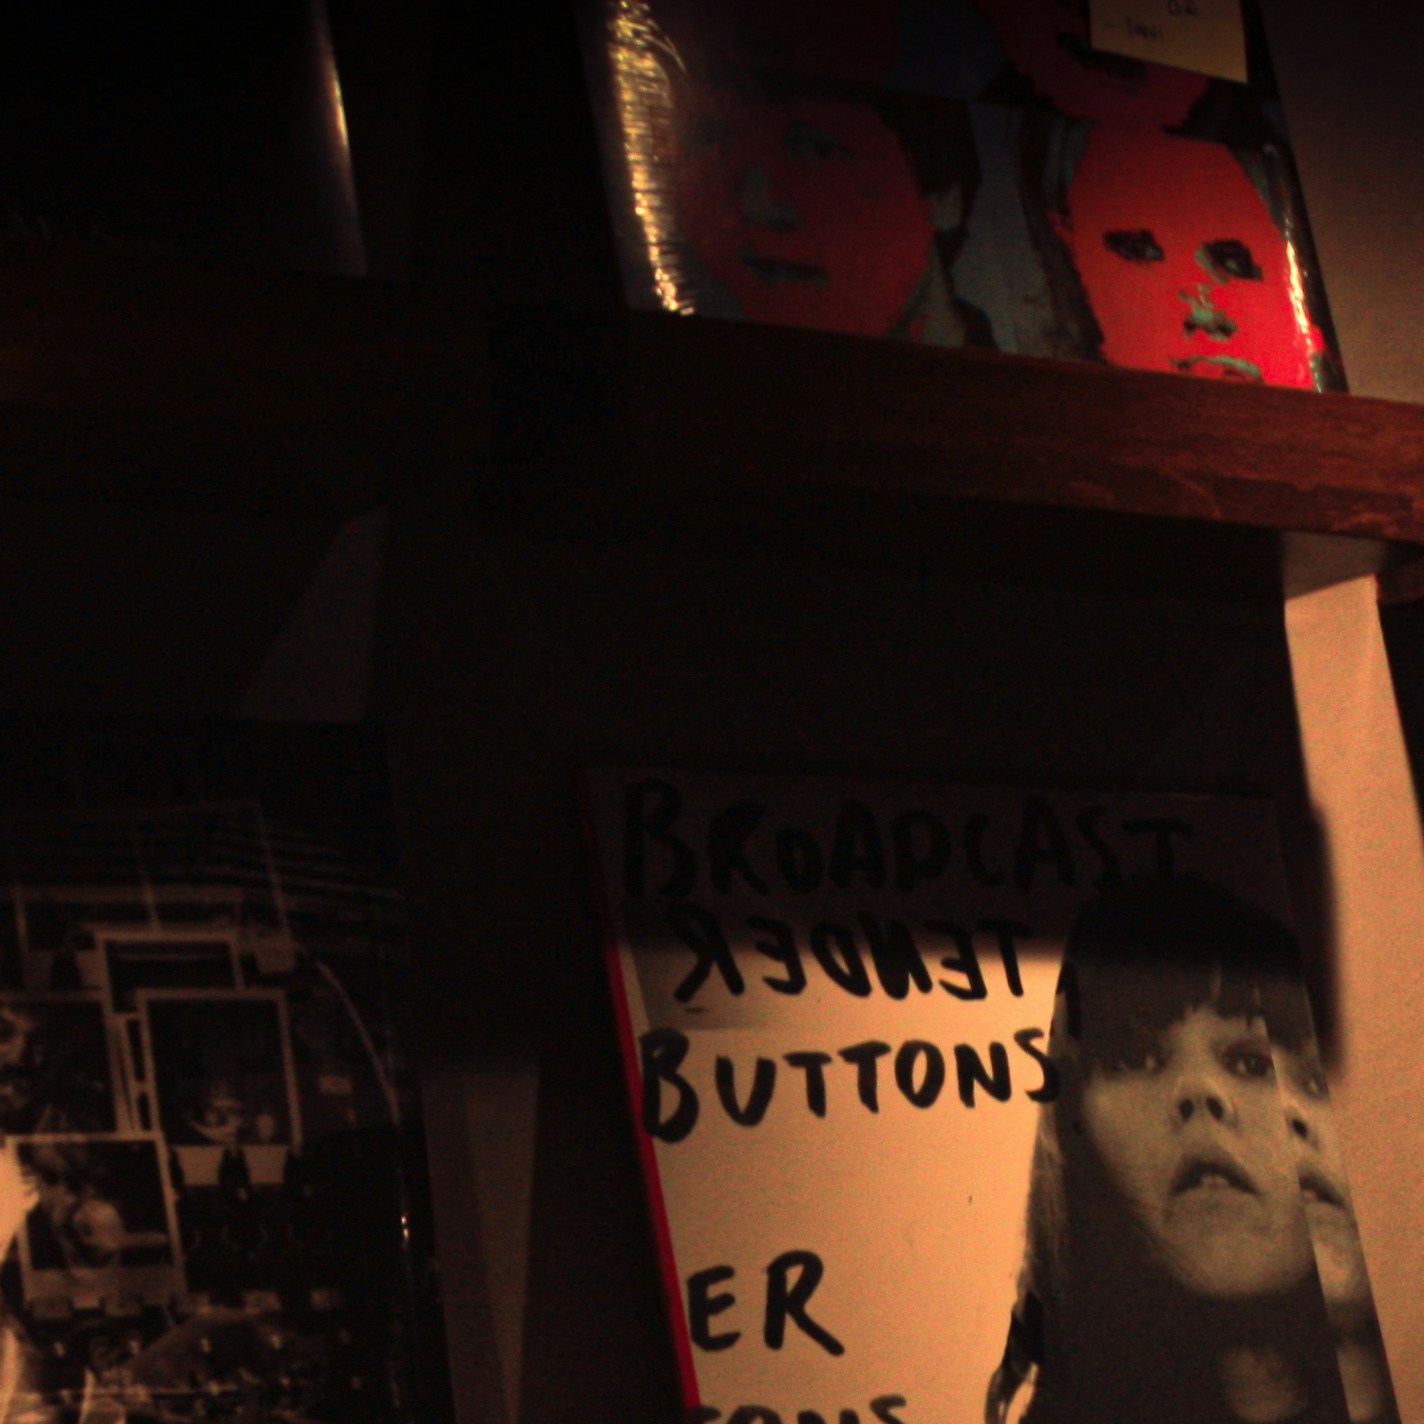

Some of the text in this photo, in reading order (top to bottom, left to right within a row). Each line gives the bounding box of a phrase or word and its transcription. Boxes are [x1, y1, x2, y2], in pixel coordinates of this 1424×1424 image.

[622, 778, 1193, 898] BROADCAST
[639, 1027, 1060, 1142] BUTTONS
[687, 1250, 844, 1356] ER
